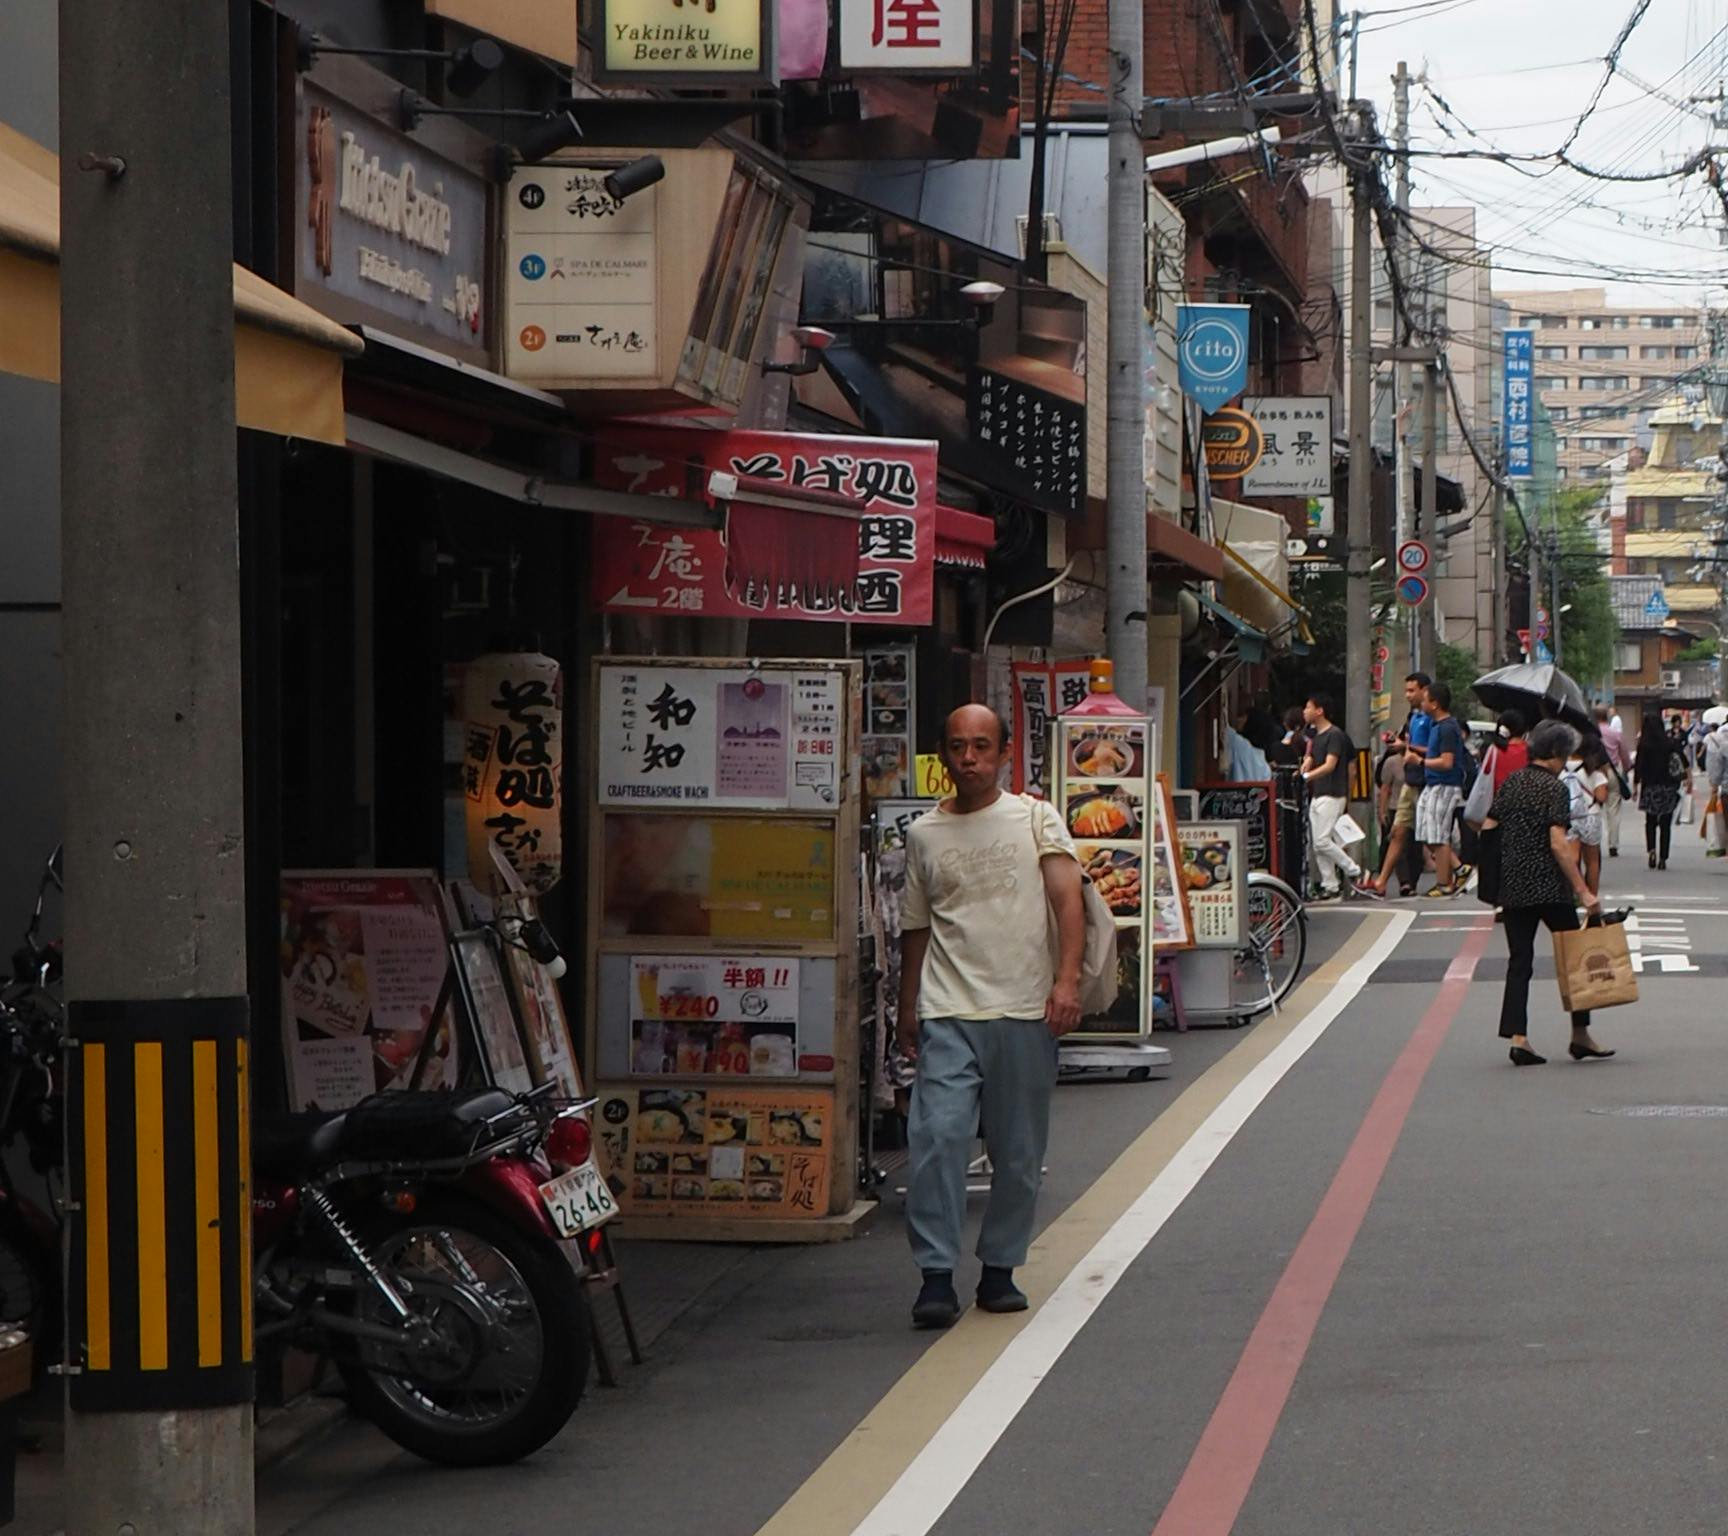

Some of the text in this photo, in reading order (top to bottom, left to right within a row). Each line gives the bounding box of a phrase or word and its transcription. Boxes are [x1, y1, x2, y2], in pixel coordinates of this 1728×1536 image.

[614, 24, 711, 42] Yakiniku
[634, 43, 754, 60] Beer & Wine
[1194, 340, 1233, 358] rita
[1194, 385, 1229, 394] KYOTO
[1404, 550, 1422, 564] 20
[661, 586, 704, 611] 2階
[640, 682, 697, 774] 和知
